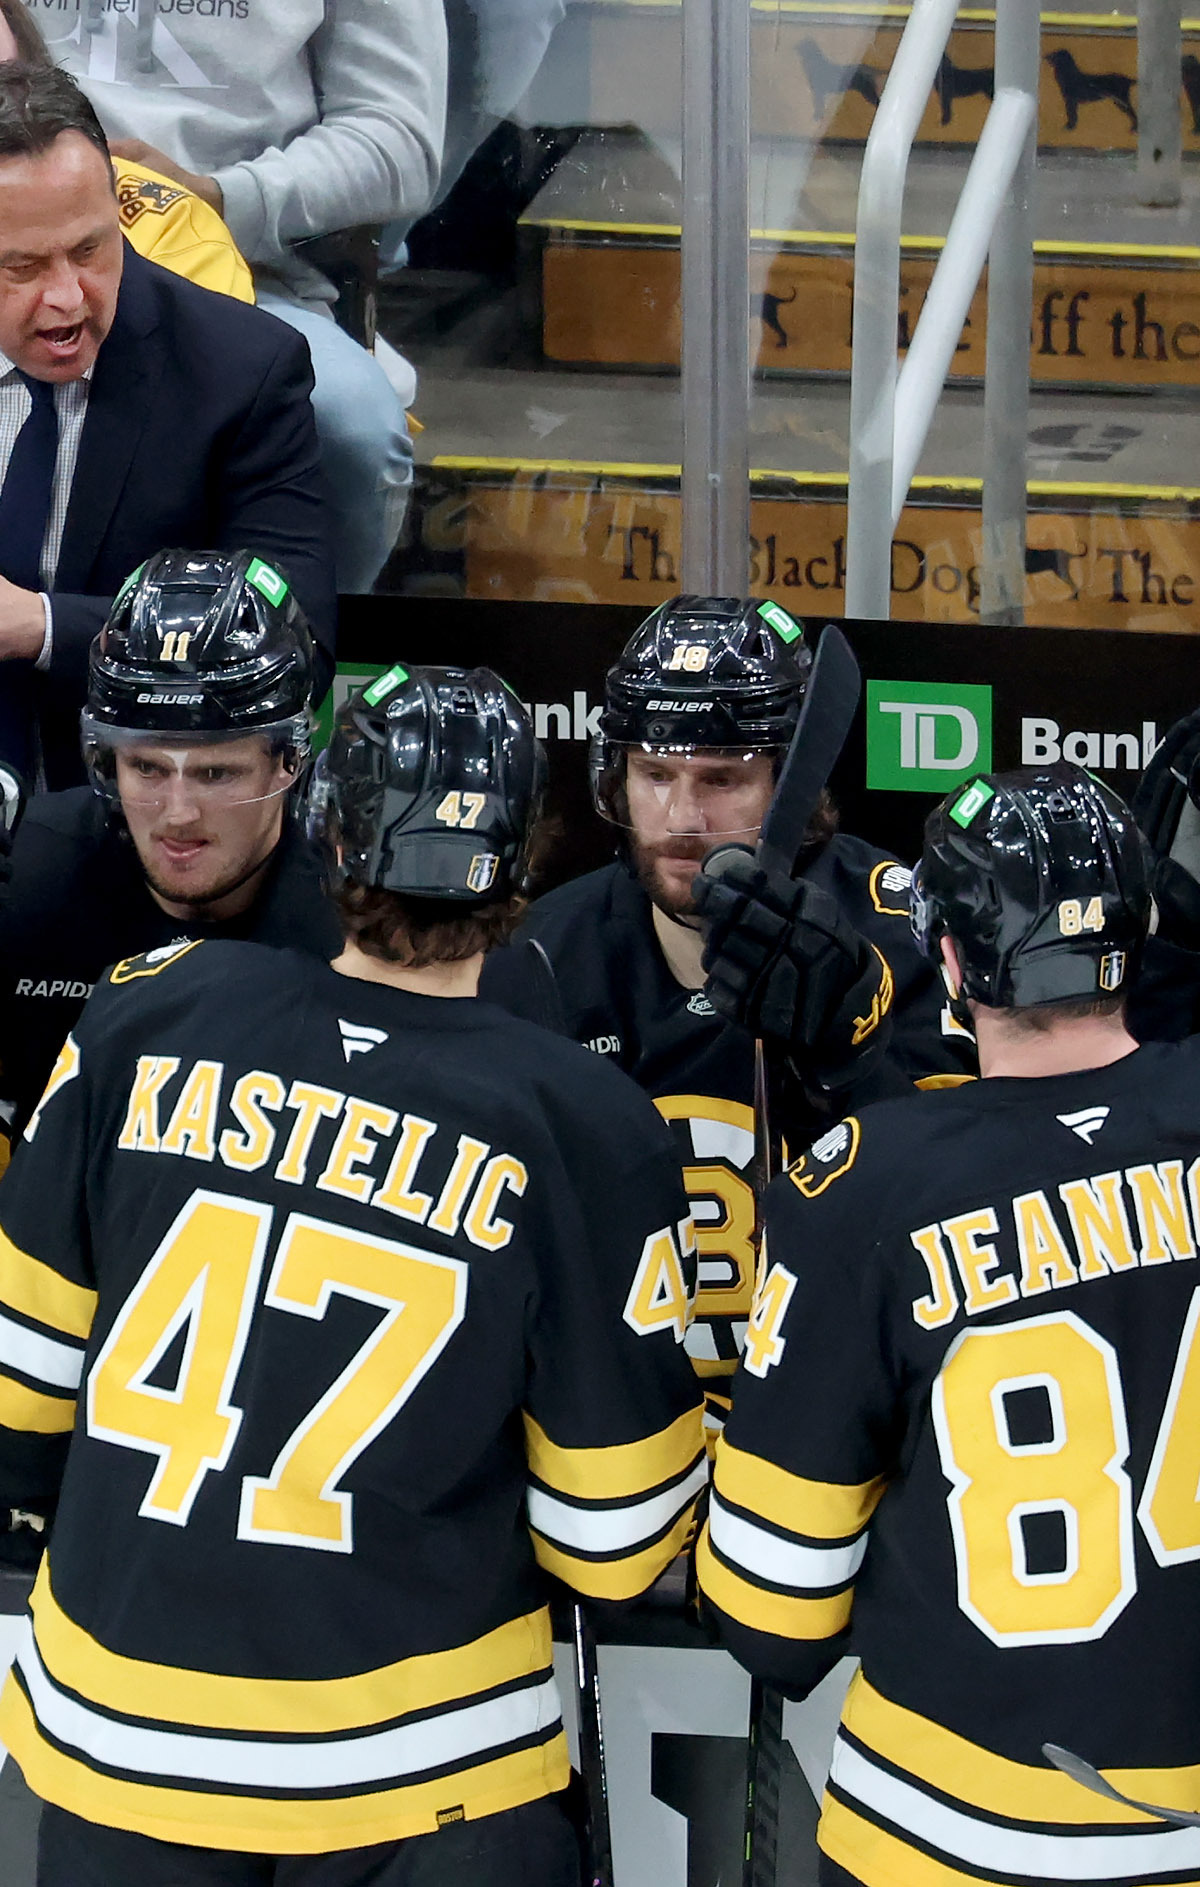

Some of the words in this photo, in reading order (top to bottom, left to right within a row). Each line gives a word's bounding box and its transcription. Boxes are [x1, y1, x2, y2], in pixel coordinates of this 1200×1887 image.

[1031, 290, 1090, 357] ff
[608, 526, 677, 582] Th
[1101, 549, 1194, 605] The
[160, 630, 192, 662] 11
[669, 645, 710, 673] 18
[524, 691, 605, 741] nk
[879, 702, 979, 771] TD
[436, 790, 486, 829] 47
[1059, 896, 1105, 936] 84
[117, 1055, 529, 1252] KASTELIC
[910, 1155, 1200, 1331] JEANN
[87, 1188, 469, 1554] 47
